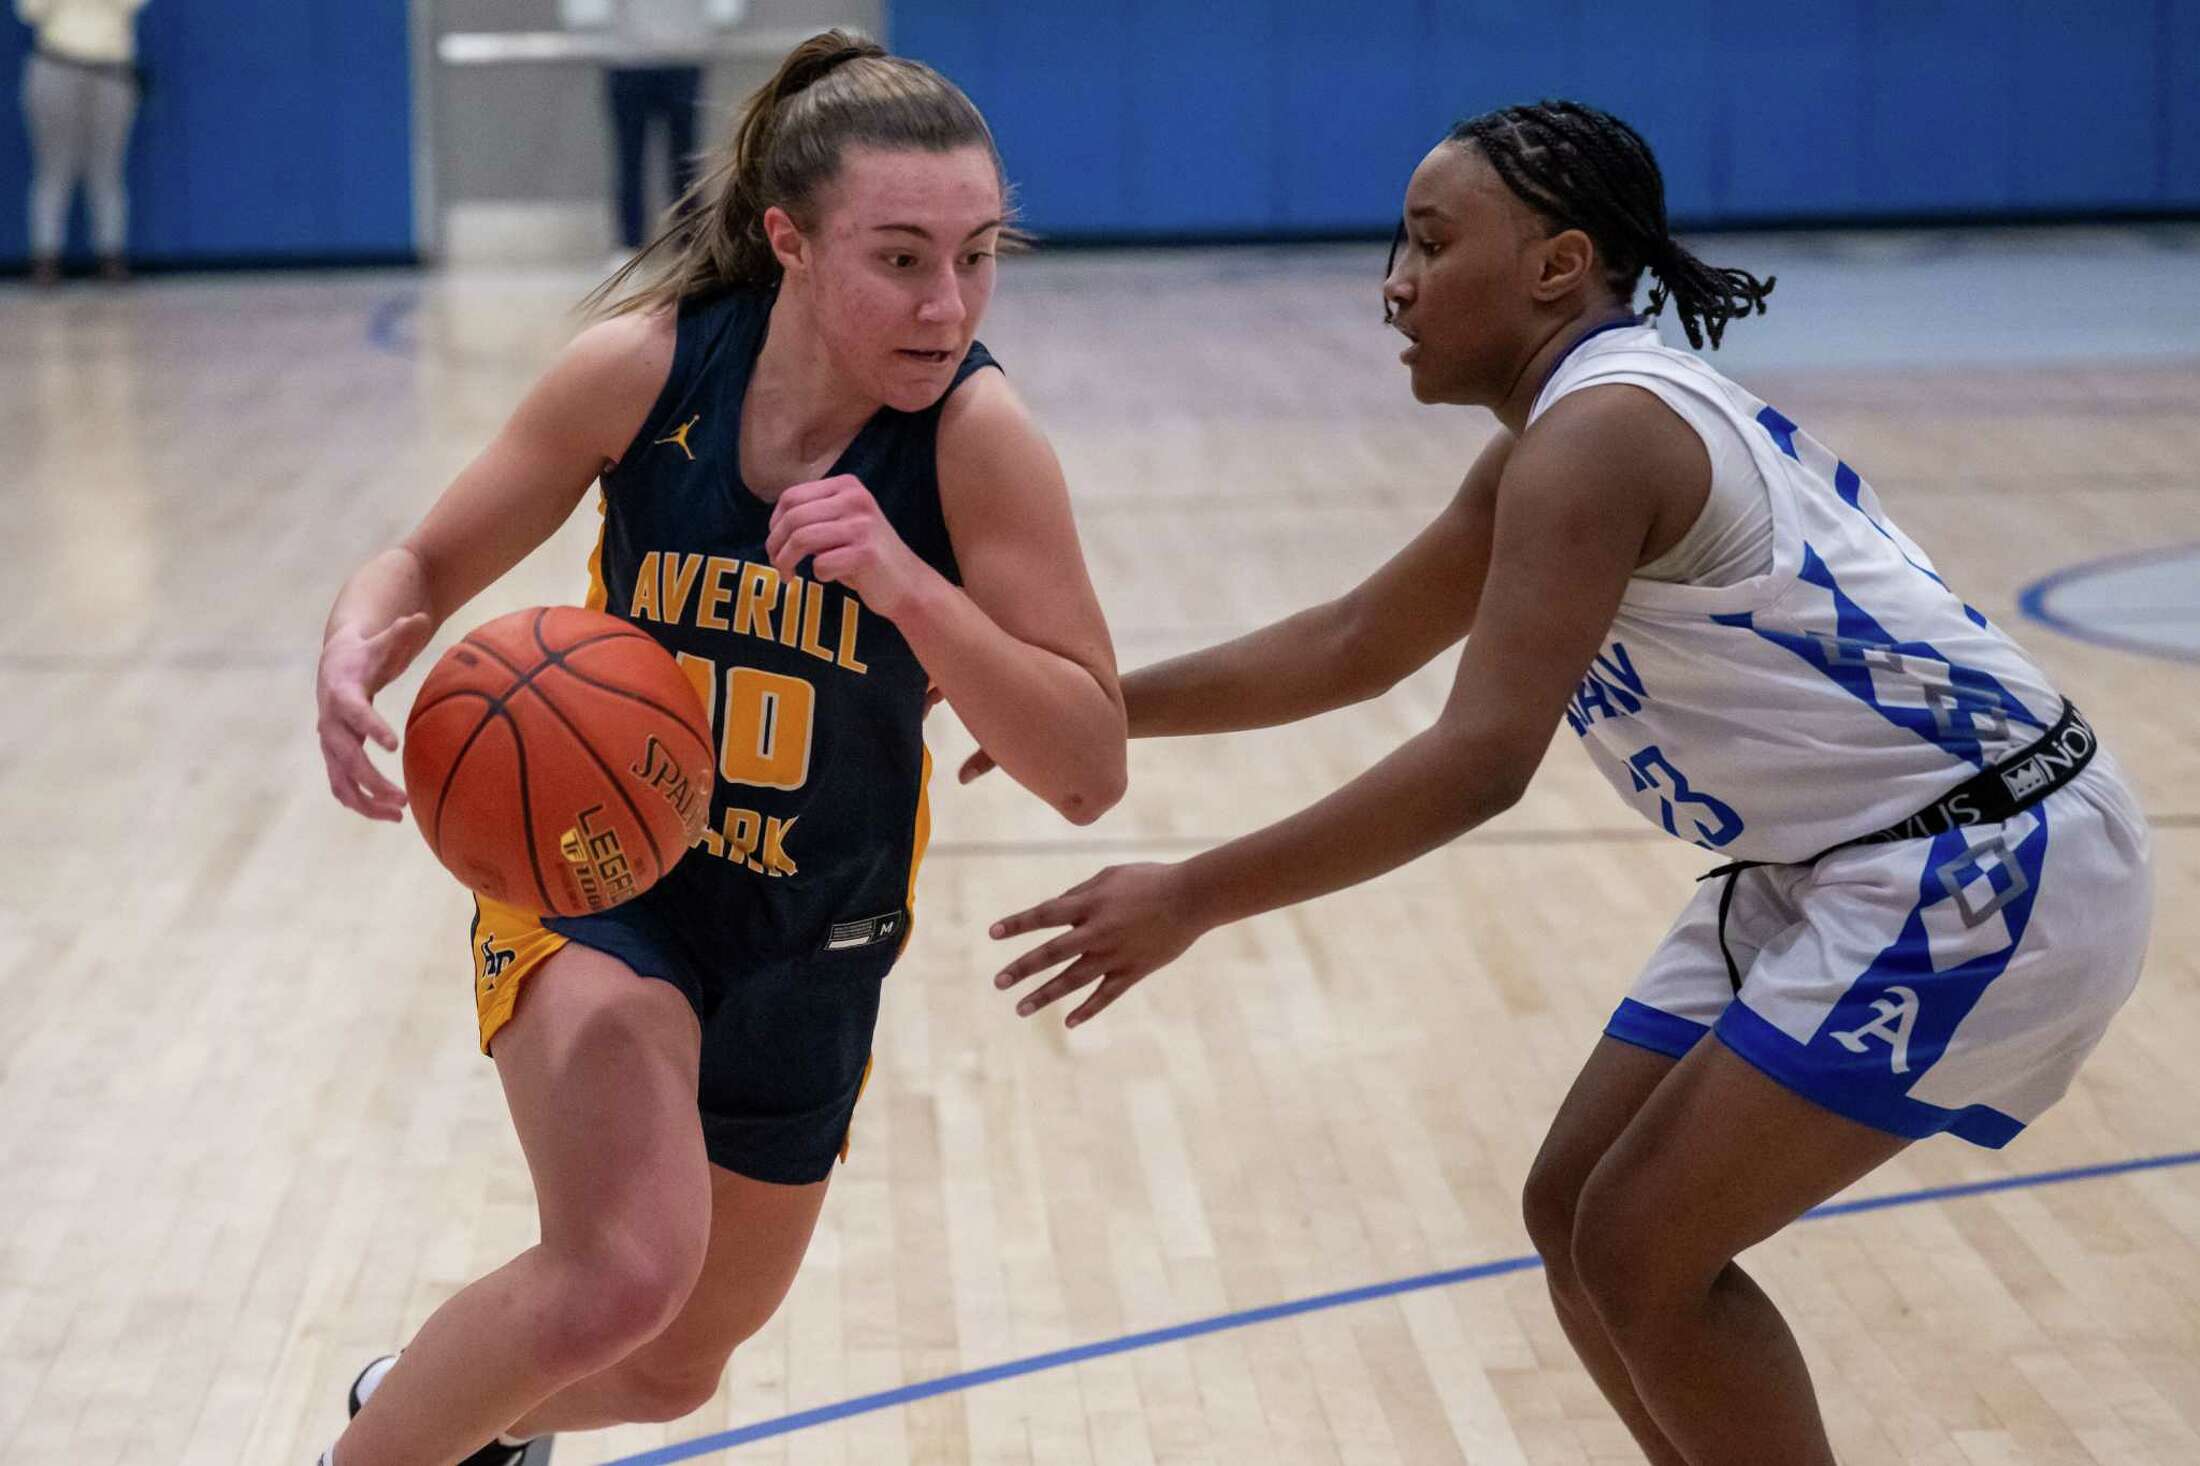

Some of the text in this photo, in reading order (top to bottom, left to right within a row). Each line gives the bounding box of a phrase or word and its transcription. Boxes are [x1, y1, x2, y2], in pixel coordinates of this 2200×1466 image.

[631, 551, 867, 674] AVERILL
[689, 807, 799, 877] ARK
[1829, 986, 1920, 1074] A
